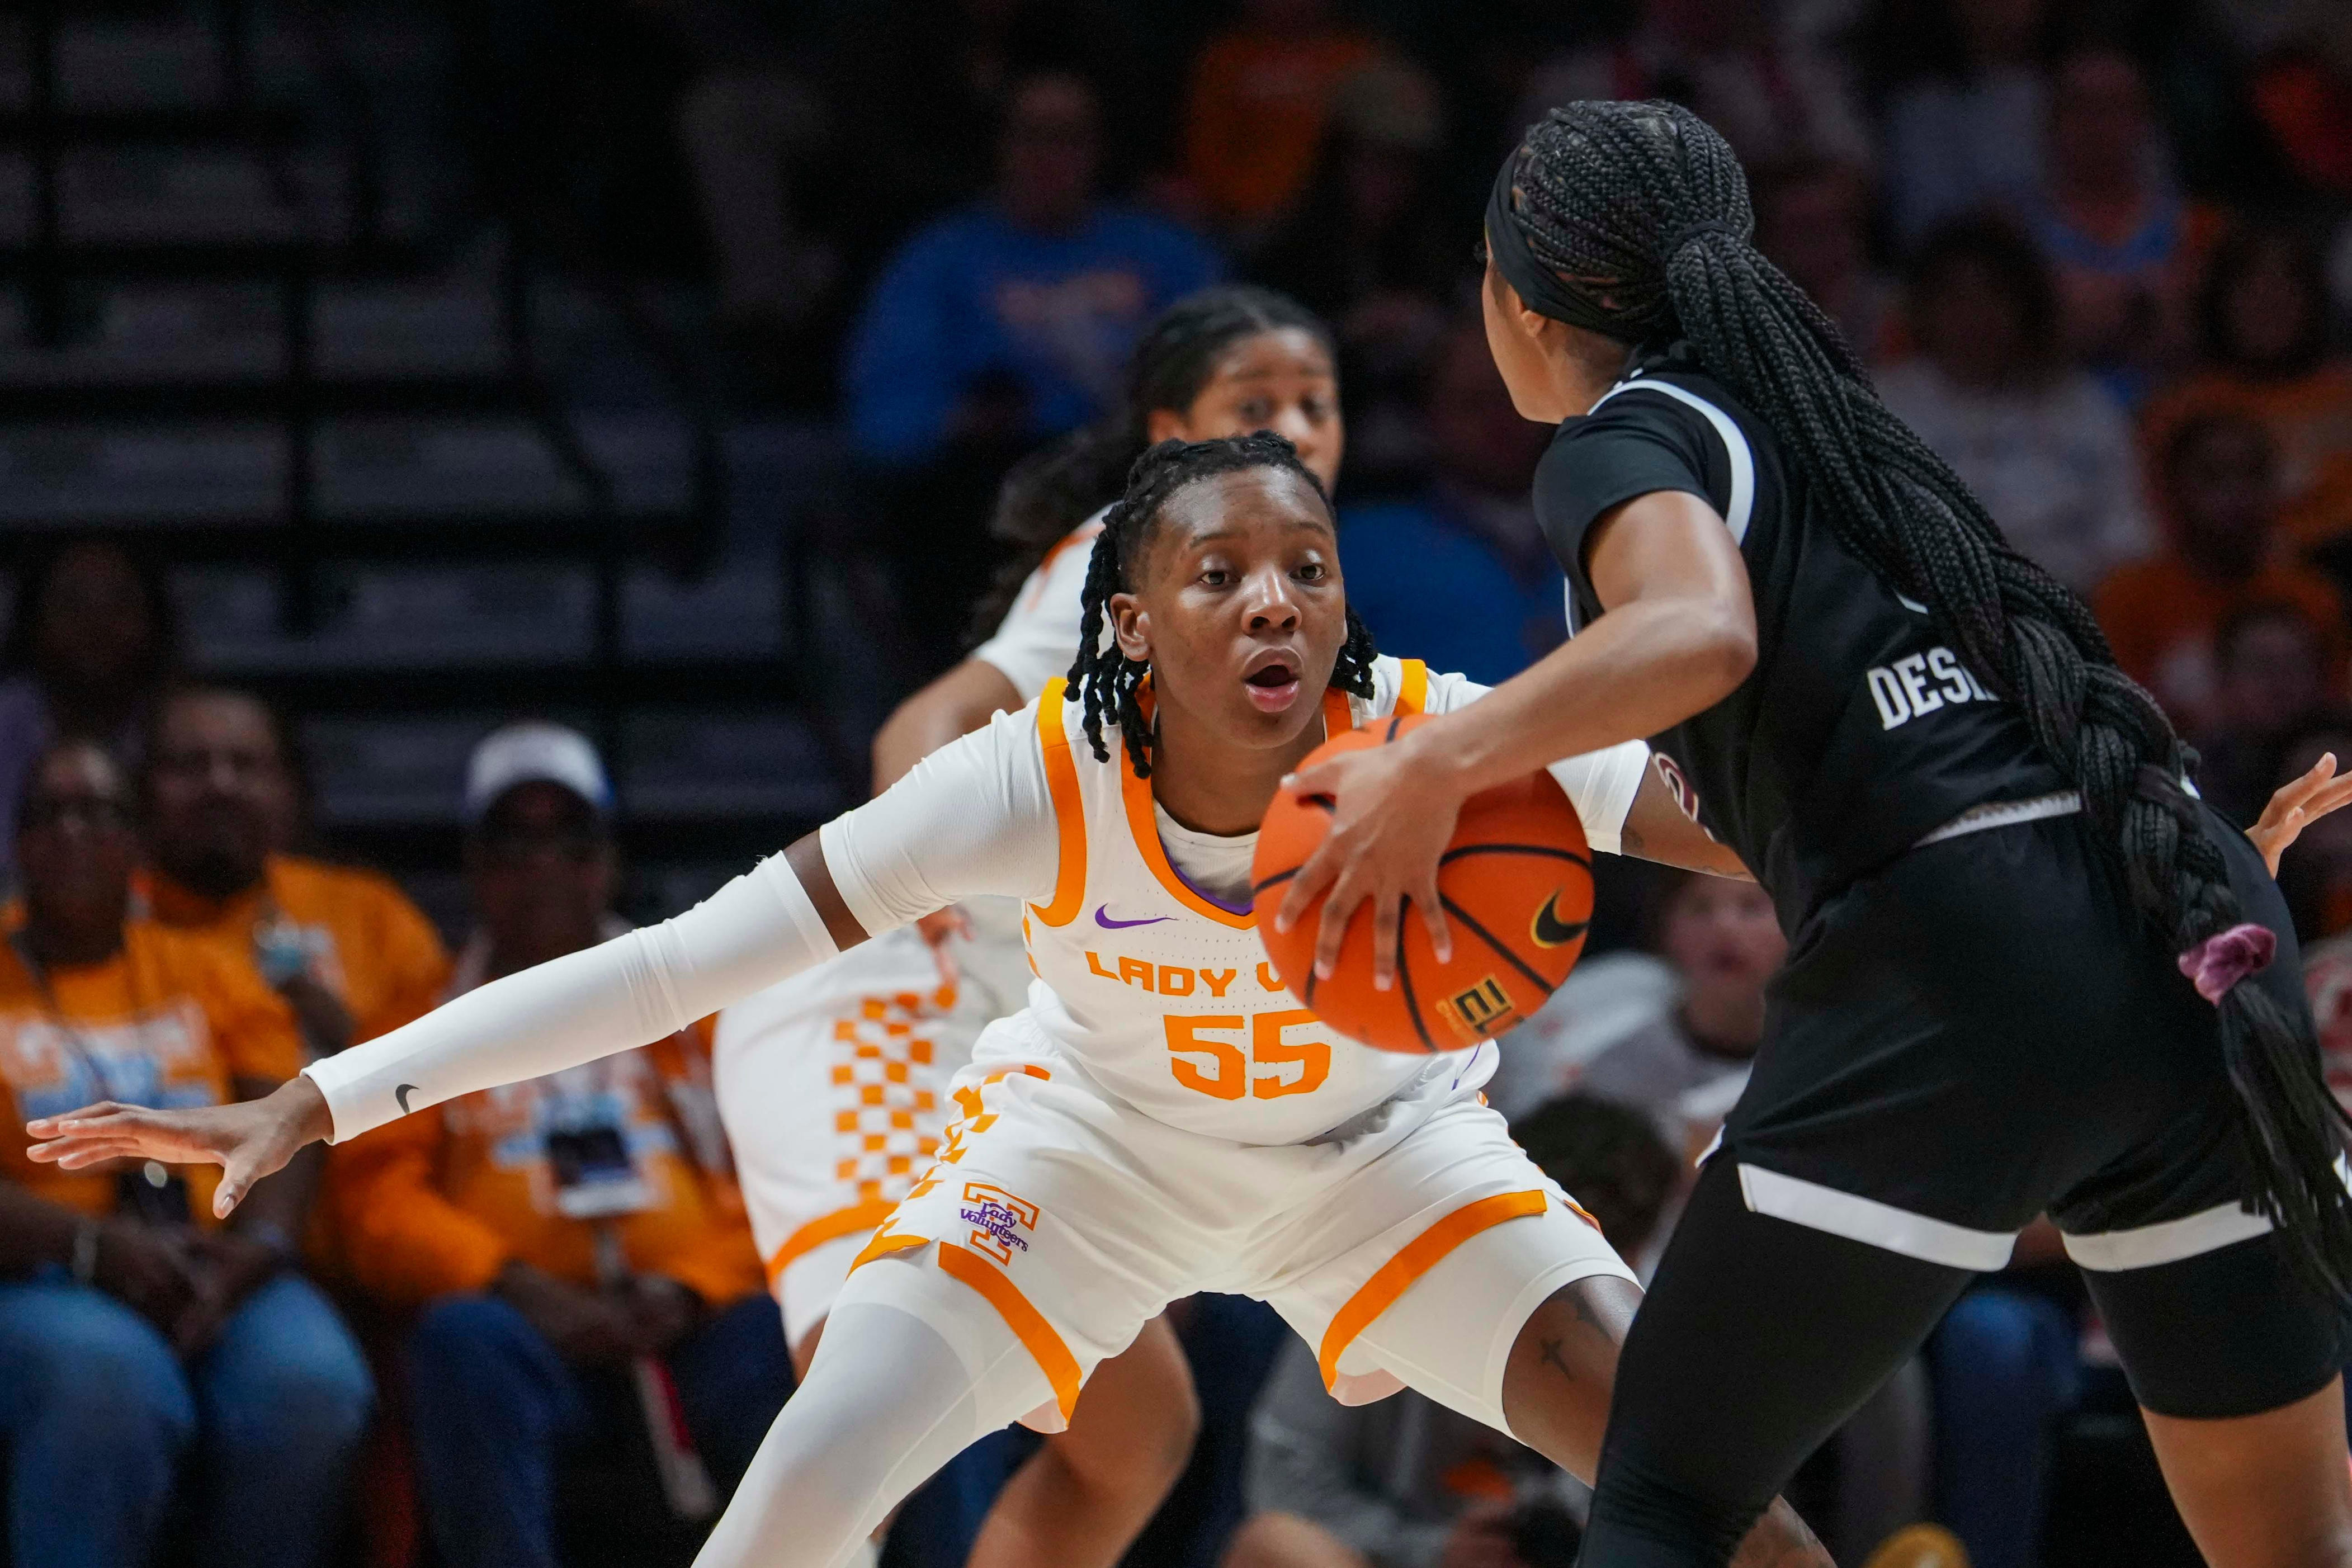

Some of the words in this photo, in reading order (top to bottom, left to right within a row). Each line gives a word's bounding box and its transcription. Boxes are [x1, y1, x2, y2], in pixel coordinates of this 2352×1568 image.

[1867, 646, 2000, 731] DES
[1085, 951, 1236, 996] LADY
[1163, 1008, 1331, 1100] 55
[960, 1208, 1028, 1252] Volunteers
[982, 1202, 1017, 1228] Lady
